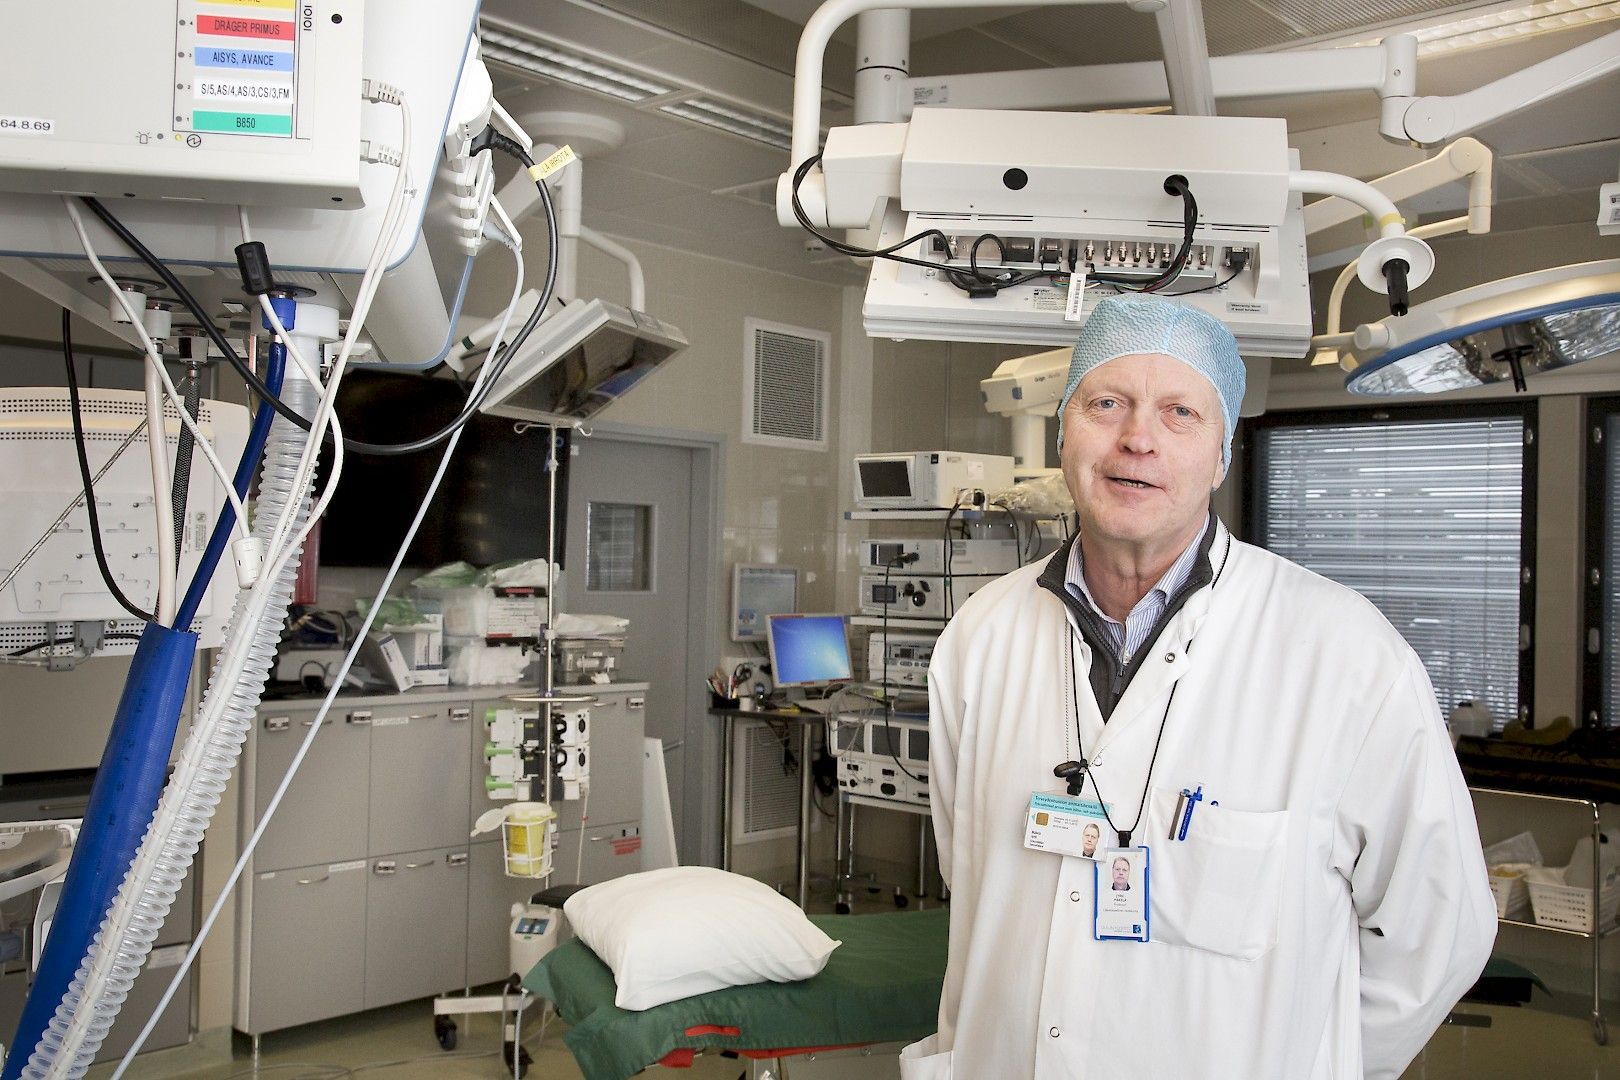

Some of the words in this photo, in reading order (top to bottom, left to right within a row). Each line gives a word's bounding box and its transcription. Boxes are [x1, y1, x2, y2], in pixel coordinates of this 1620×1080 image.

[214, 19, 247, 32] DRAGER
[250, 22, 280, 35] PRIMUS
[212, 52, 239, 64] AISYS,
[242, 53, 274, 66] AVANCE
[201, 83, 290, 99] S/5,AS/4,AS/3,CS/3,FM
[0, 119, 50, 131] 64.8.69
[236, 117, 256, 129] B850
